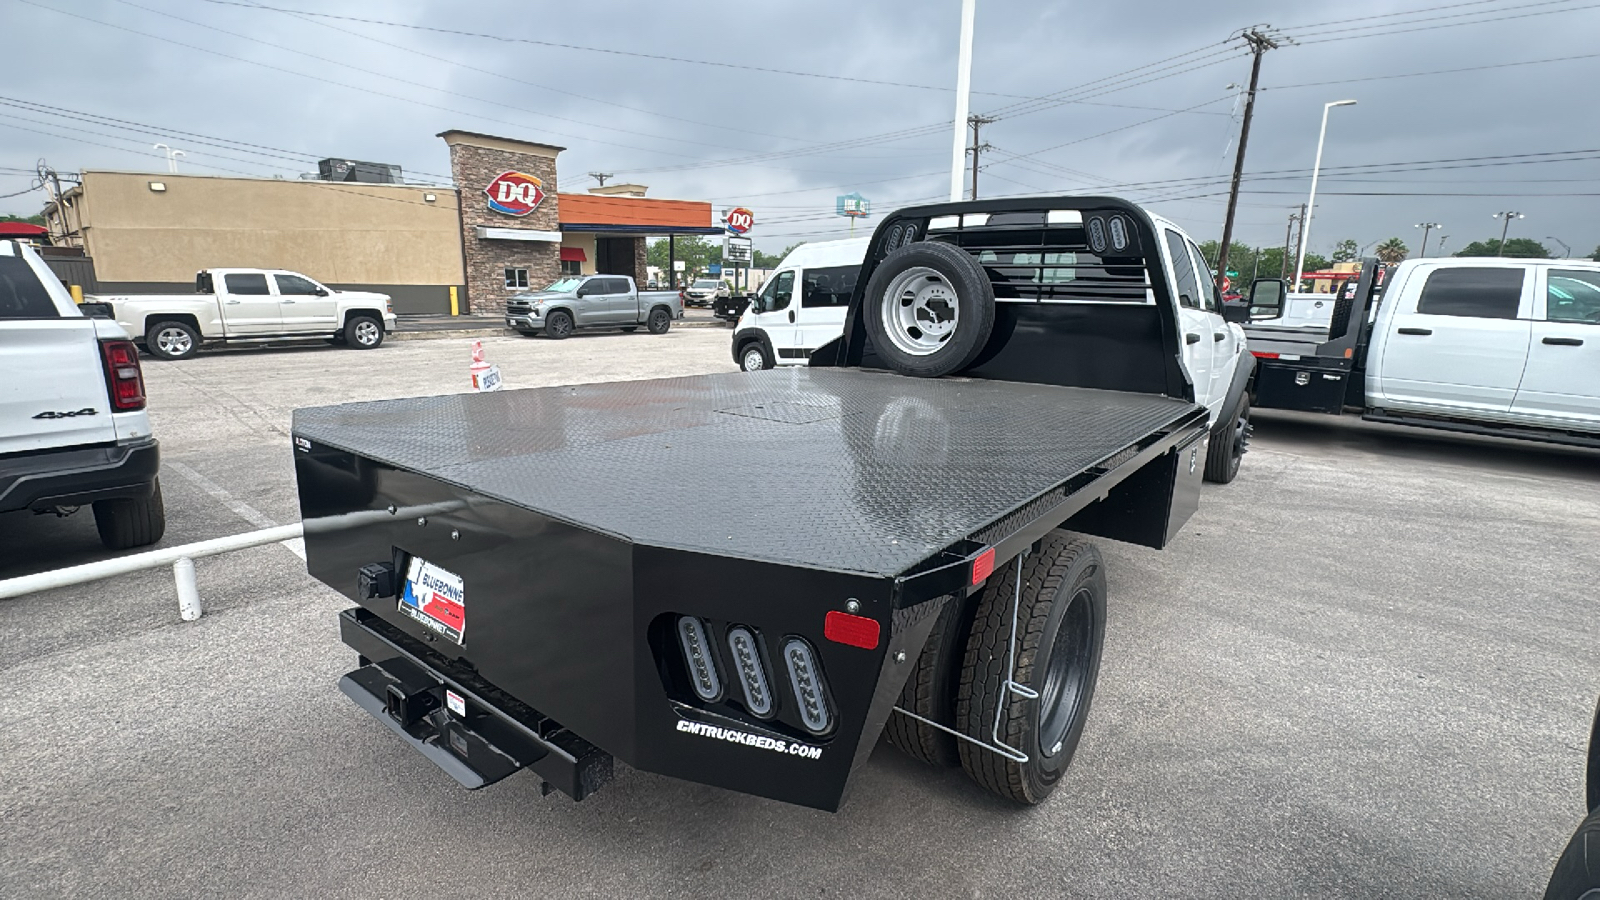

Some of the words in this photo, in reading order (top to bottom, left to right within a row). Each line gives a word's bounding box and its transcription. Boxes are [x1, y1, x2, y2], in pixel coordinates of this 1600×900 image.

[497, 180, 536, 207] DQ
[731, 213, 750, 229] DQ
[422, 573, 464, 602] BLUEBONNE
[676, 720, 823, 760] CMTRUCKBEDS.COM
